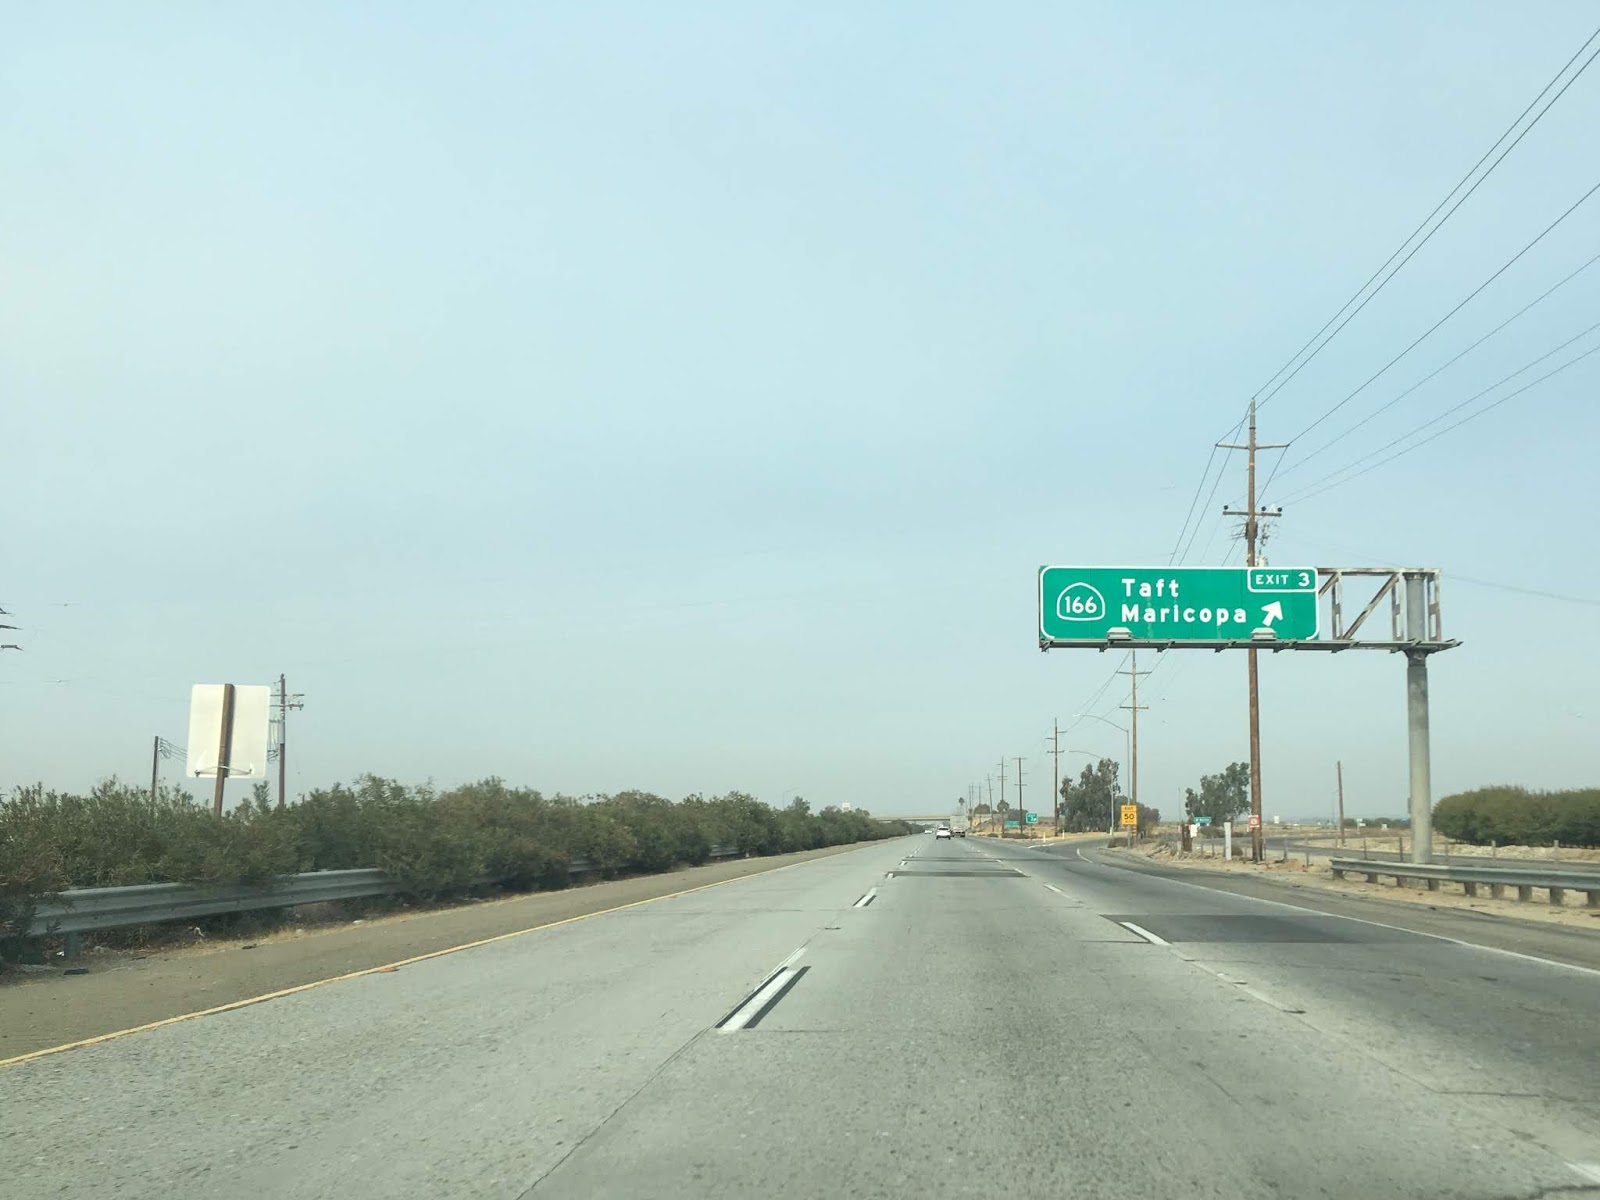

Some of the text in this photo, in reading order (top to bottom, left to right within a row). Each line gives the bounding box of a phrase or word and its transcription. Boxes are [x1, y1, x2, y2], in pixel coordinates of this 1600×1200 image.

[1121, 578, 1179, 598] Taft
[1255, 572, 1311, 588] EXIT 3
[1064, 595, 1098, 614] 166
[1121, 603, 1247, 626] Maricopa
